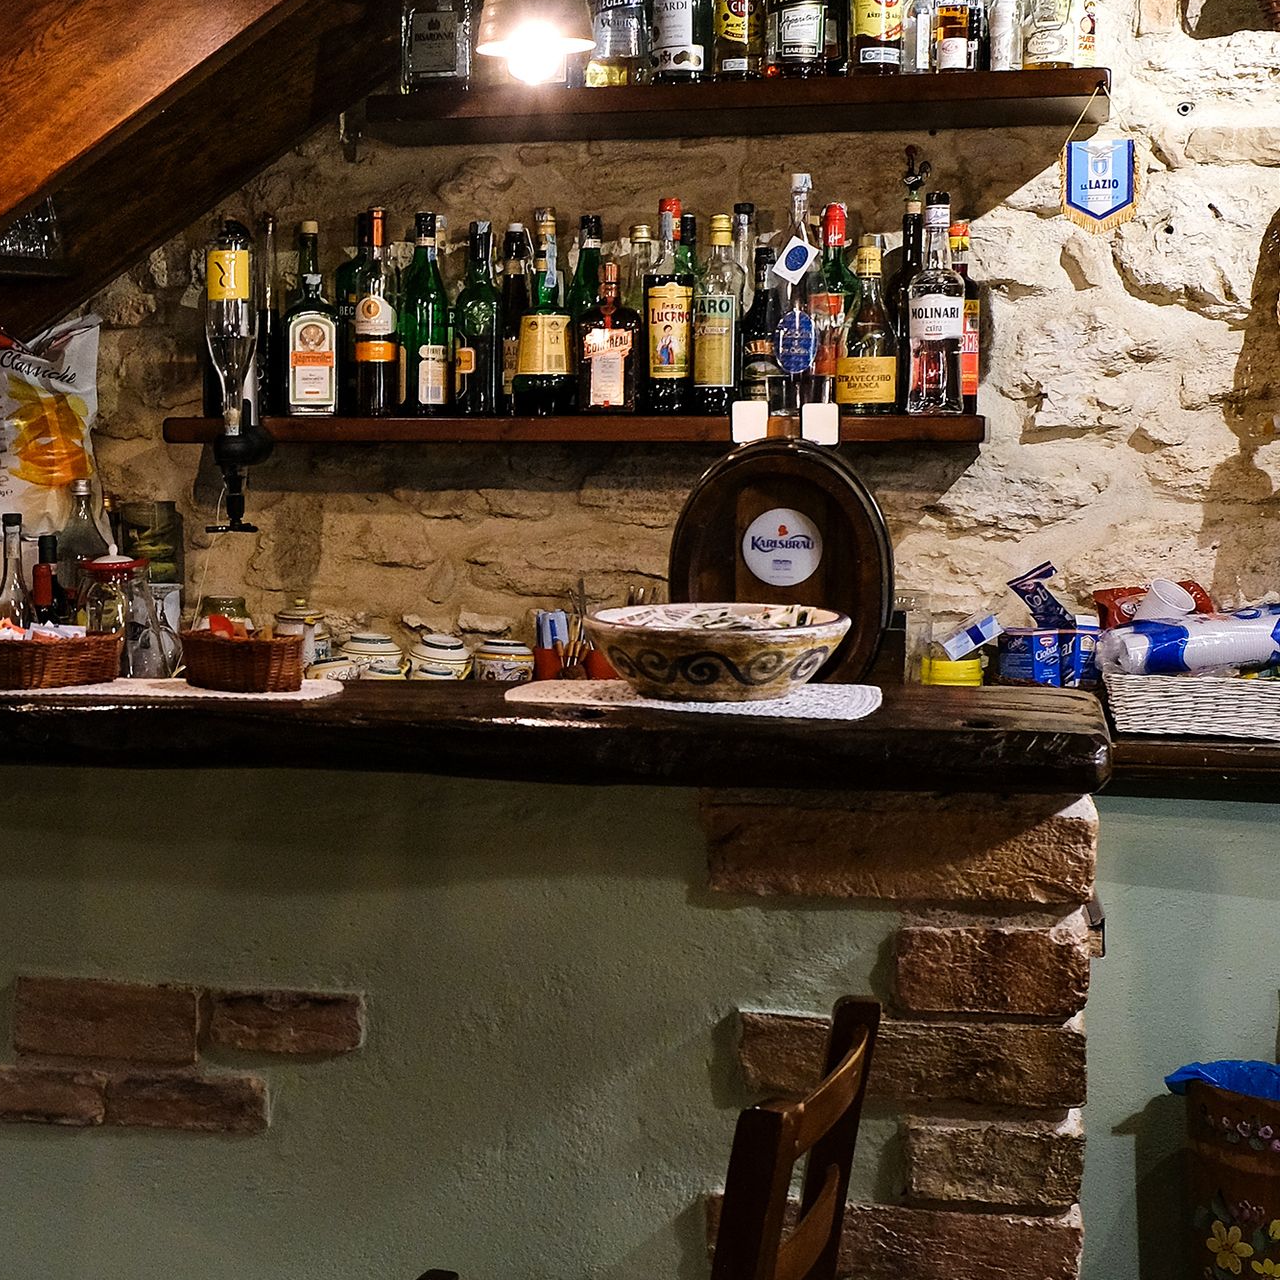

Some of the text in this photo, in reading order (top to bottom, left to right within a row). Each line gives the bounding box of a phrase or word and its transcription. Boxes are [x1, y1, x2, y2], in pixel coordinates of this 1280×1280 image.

[1088, 179, 1119, 190] LAZIO
[695, 299, 730, 314] ARO
[651, 308, 691, 324] LUCANO
[912, 307, 959, 319] MOLINARI
[0, 350, 77, 385] Classiche
[838, 375, 891, 384] STRAVECCHIO
[847, 382, 880, 390] BRANCA
